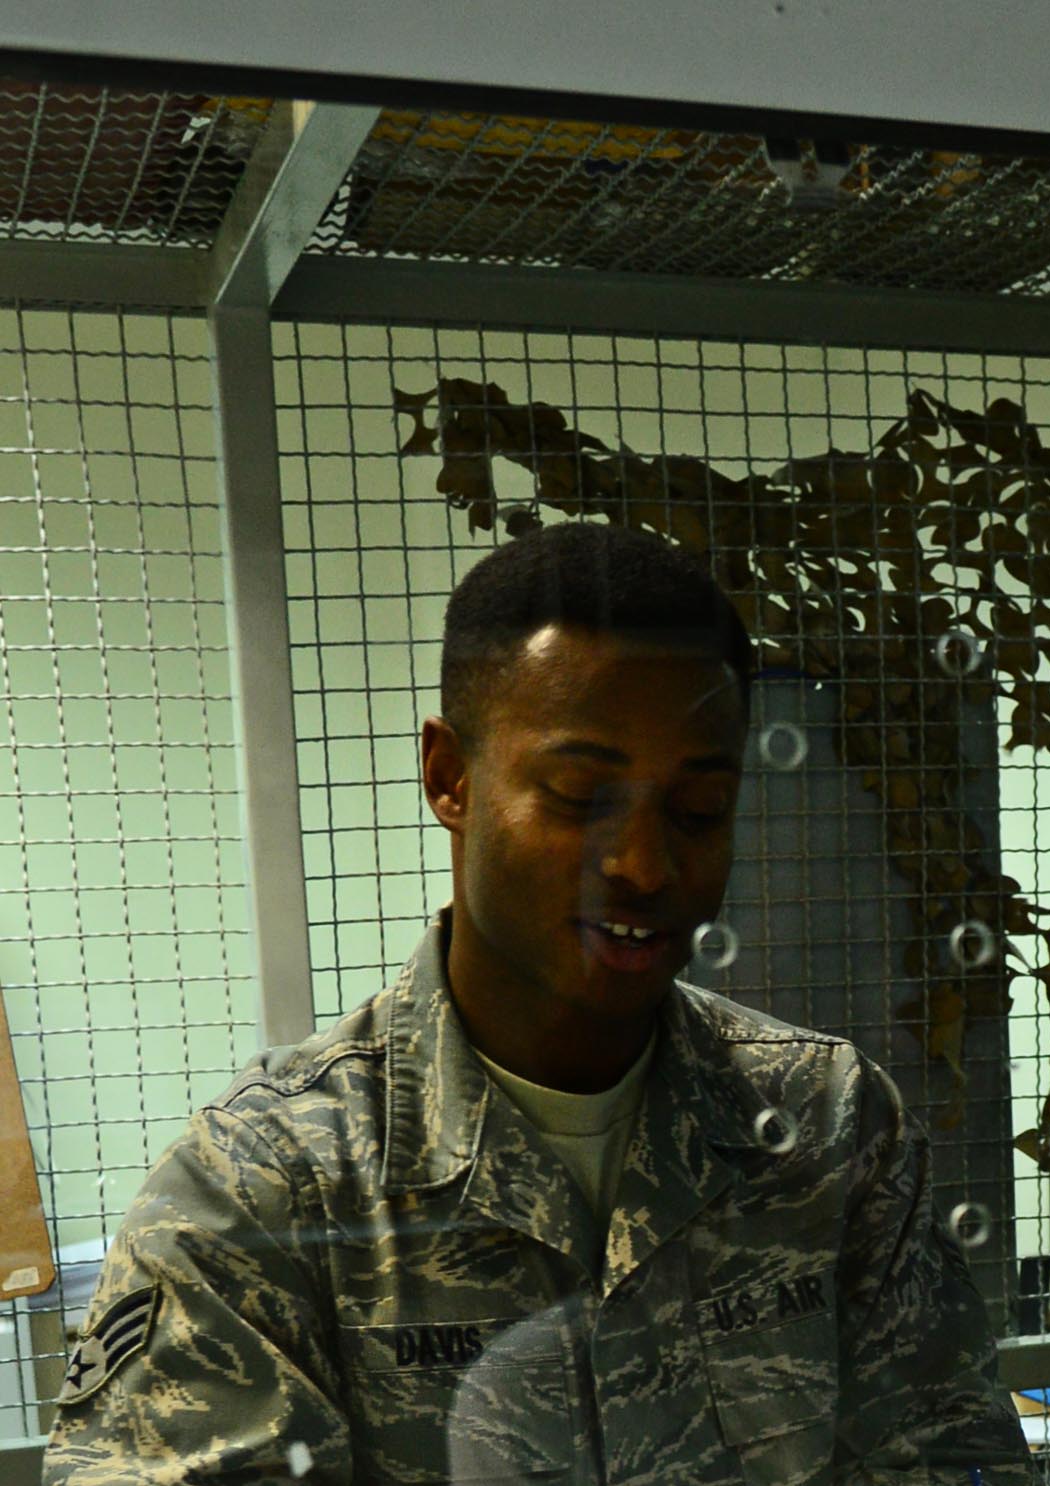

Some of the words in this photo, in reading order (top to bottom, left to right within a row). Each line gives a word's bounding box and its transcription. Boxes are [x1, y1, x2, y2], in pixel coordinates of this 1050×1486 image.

[713, 1293, 767, 1332] U.S.
[777, 1274, 827, 1318] AIR
[395, 1326, 484, 1366] DAVIS
